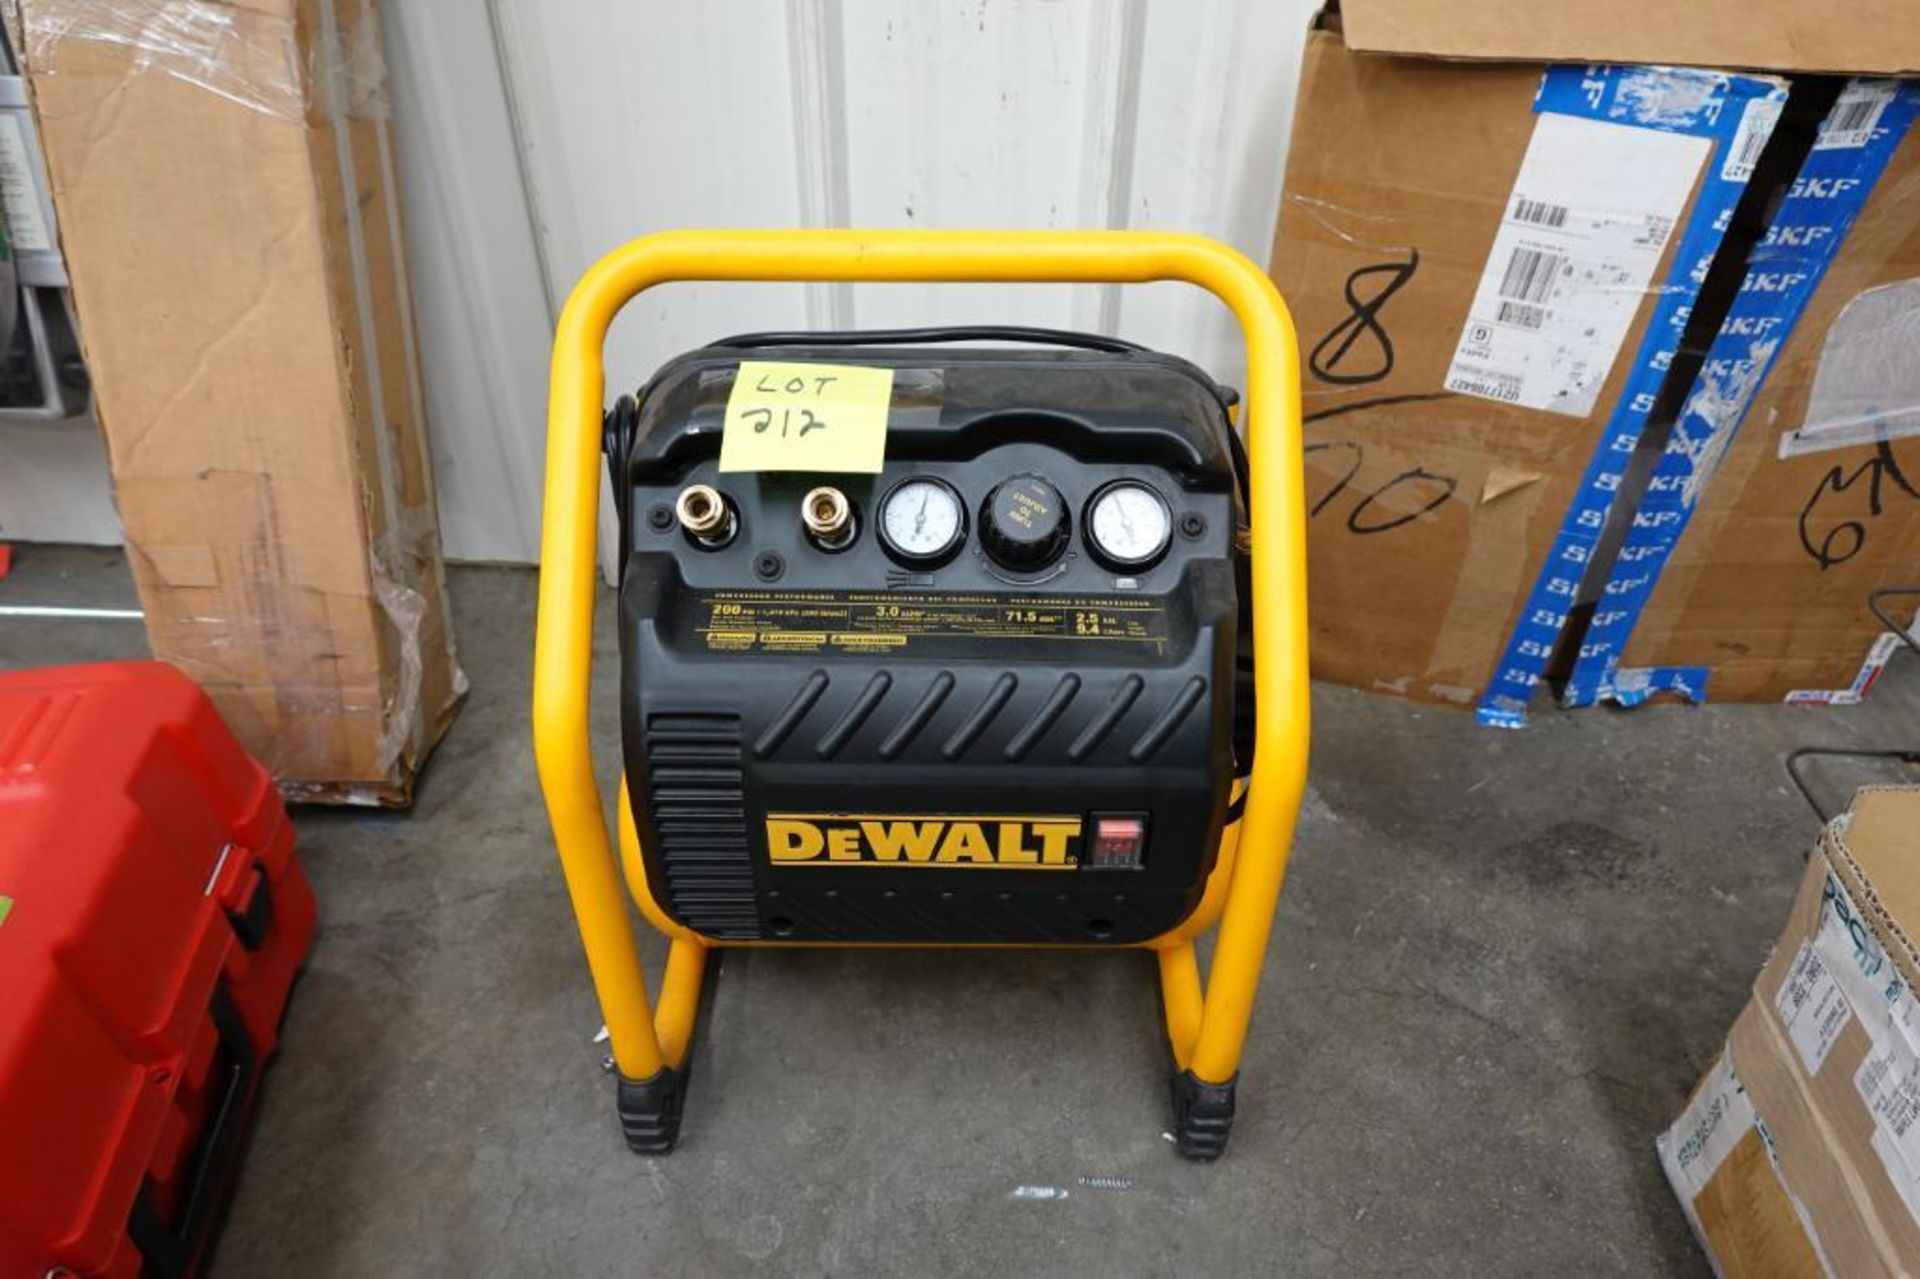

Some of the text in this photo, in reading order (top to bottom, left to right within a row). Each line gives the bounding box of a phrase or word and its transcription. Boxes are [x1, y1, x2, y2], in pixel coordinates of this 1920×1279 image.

[1309, 247, 1419, 384] 8
[756, 375, 838, 396] LOT
[740, 408, 826, 437] 212
[712, 604, 741, 616] 200
[875, 605, 900, 618] 3.0
[1005, 610, 1037, 623] 71.5
[1076, 612, 1099, 625] 2.5
